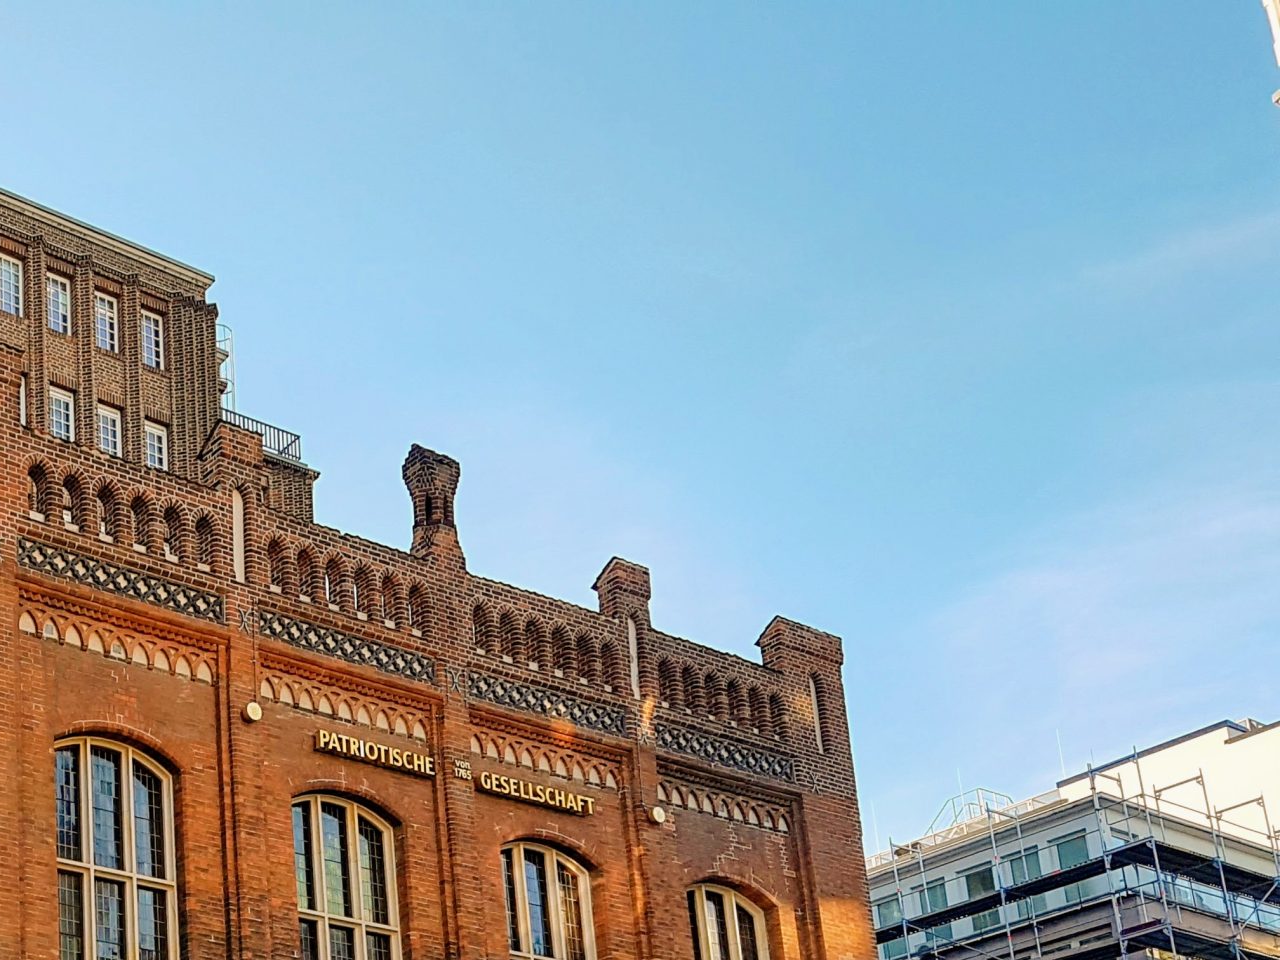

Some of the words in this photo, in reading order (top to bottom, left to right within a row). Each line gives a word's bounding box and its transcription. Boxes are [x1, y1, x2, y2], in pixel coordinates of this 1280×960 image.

[319, 729, 436, 775] PATRIOTISCHE
[454, 759, 471, 770] von
[454, 767, 472, 780] 1765
[480, 771, 595, 815] GESELLSCHAFT
